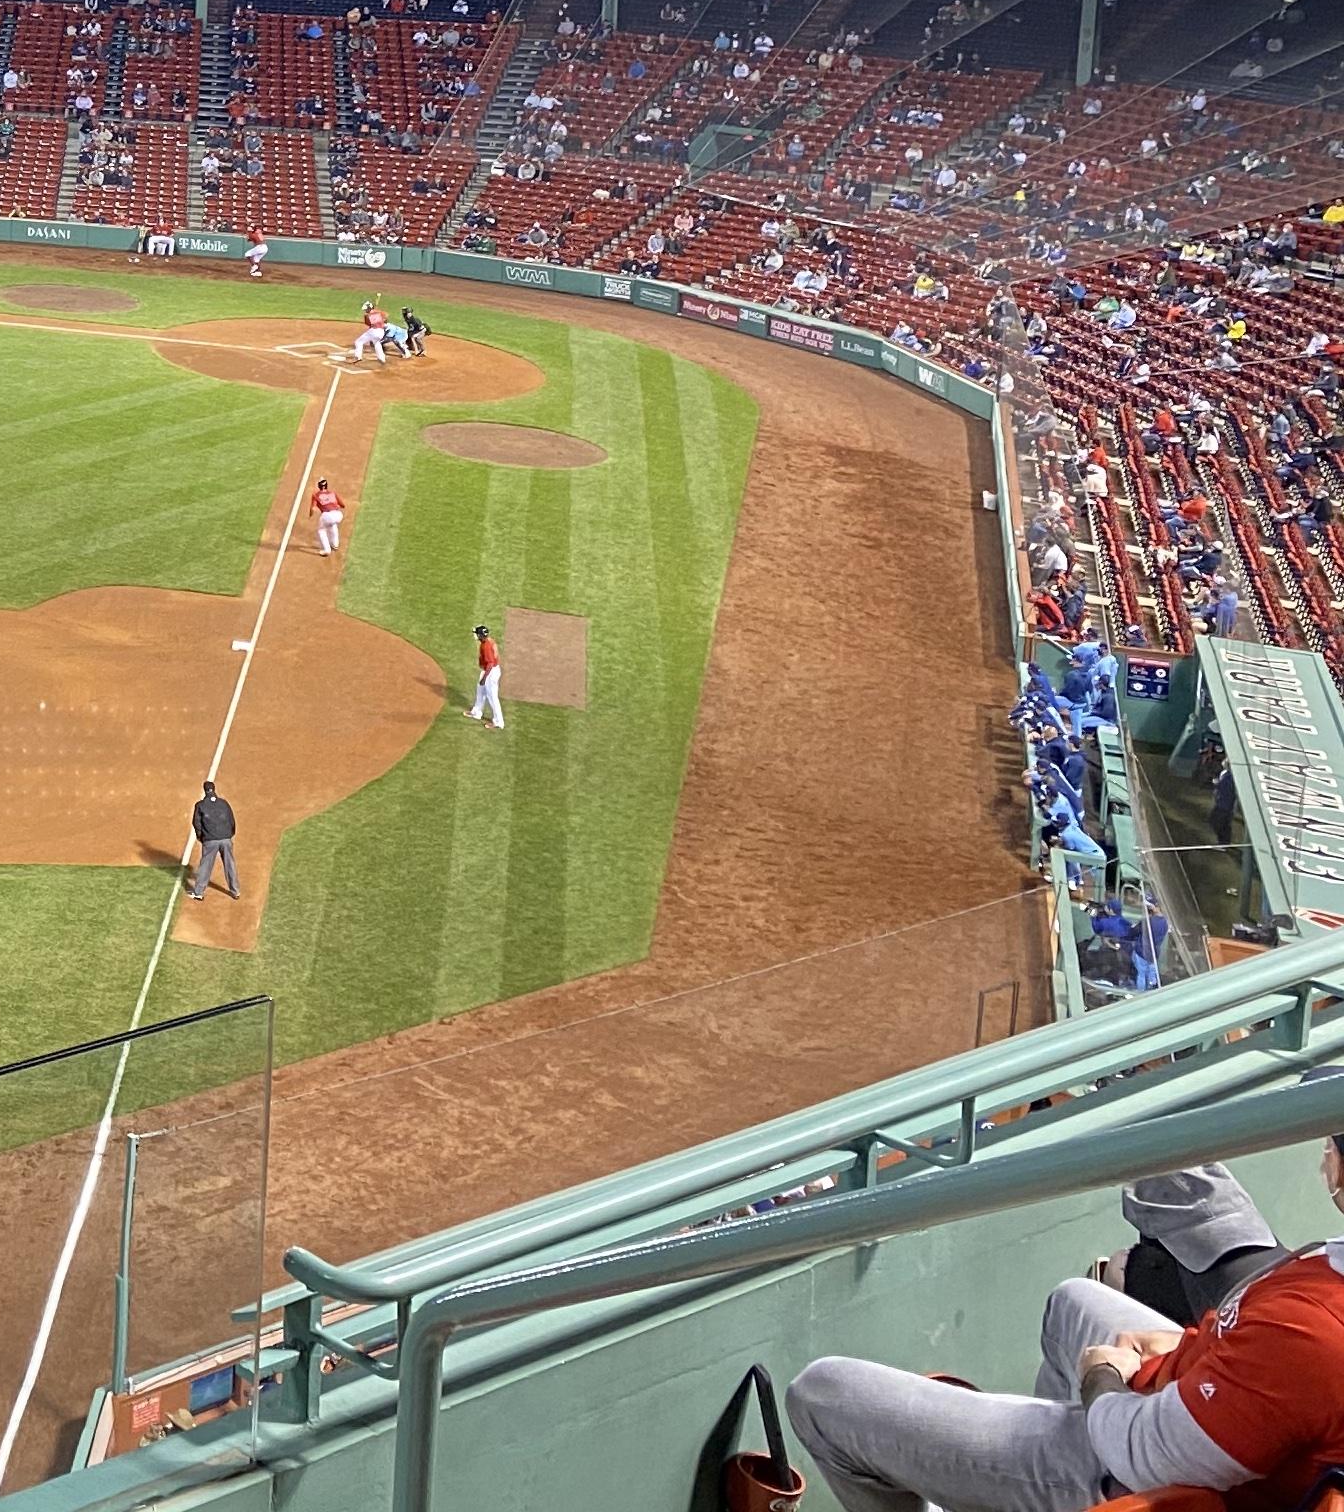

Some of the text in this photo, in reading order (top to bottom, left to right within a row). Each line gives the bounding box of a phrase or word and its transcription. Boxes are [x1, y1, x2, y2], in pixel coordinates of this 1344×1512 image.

[27, 226, 71, 240] DASANI
[337, 247, 366, 258] Ninety
[337, 254, 365, 265] Nine
[505, 266, 551, 285] WM
[682, 300, 707, 314] Ninety
[770, 319, 834, 344] KIDS EAT FREE
[1219, 647, 1344, 885] PARK FENWAY
